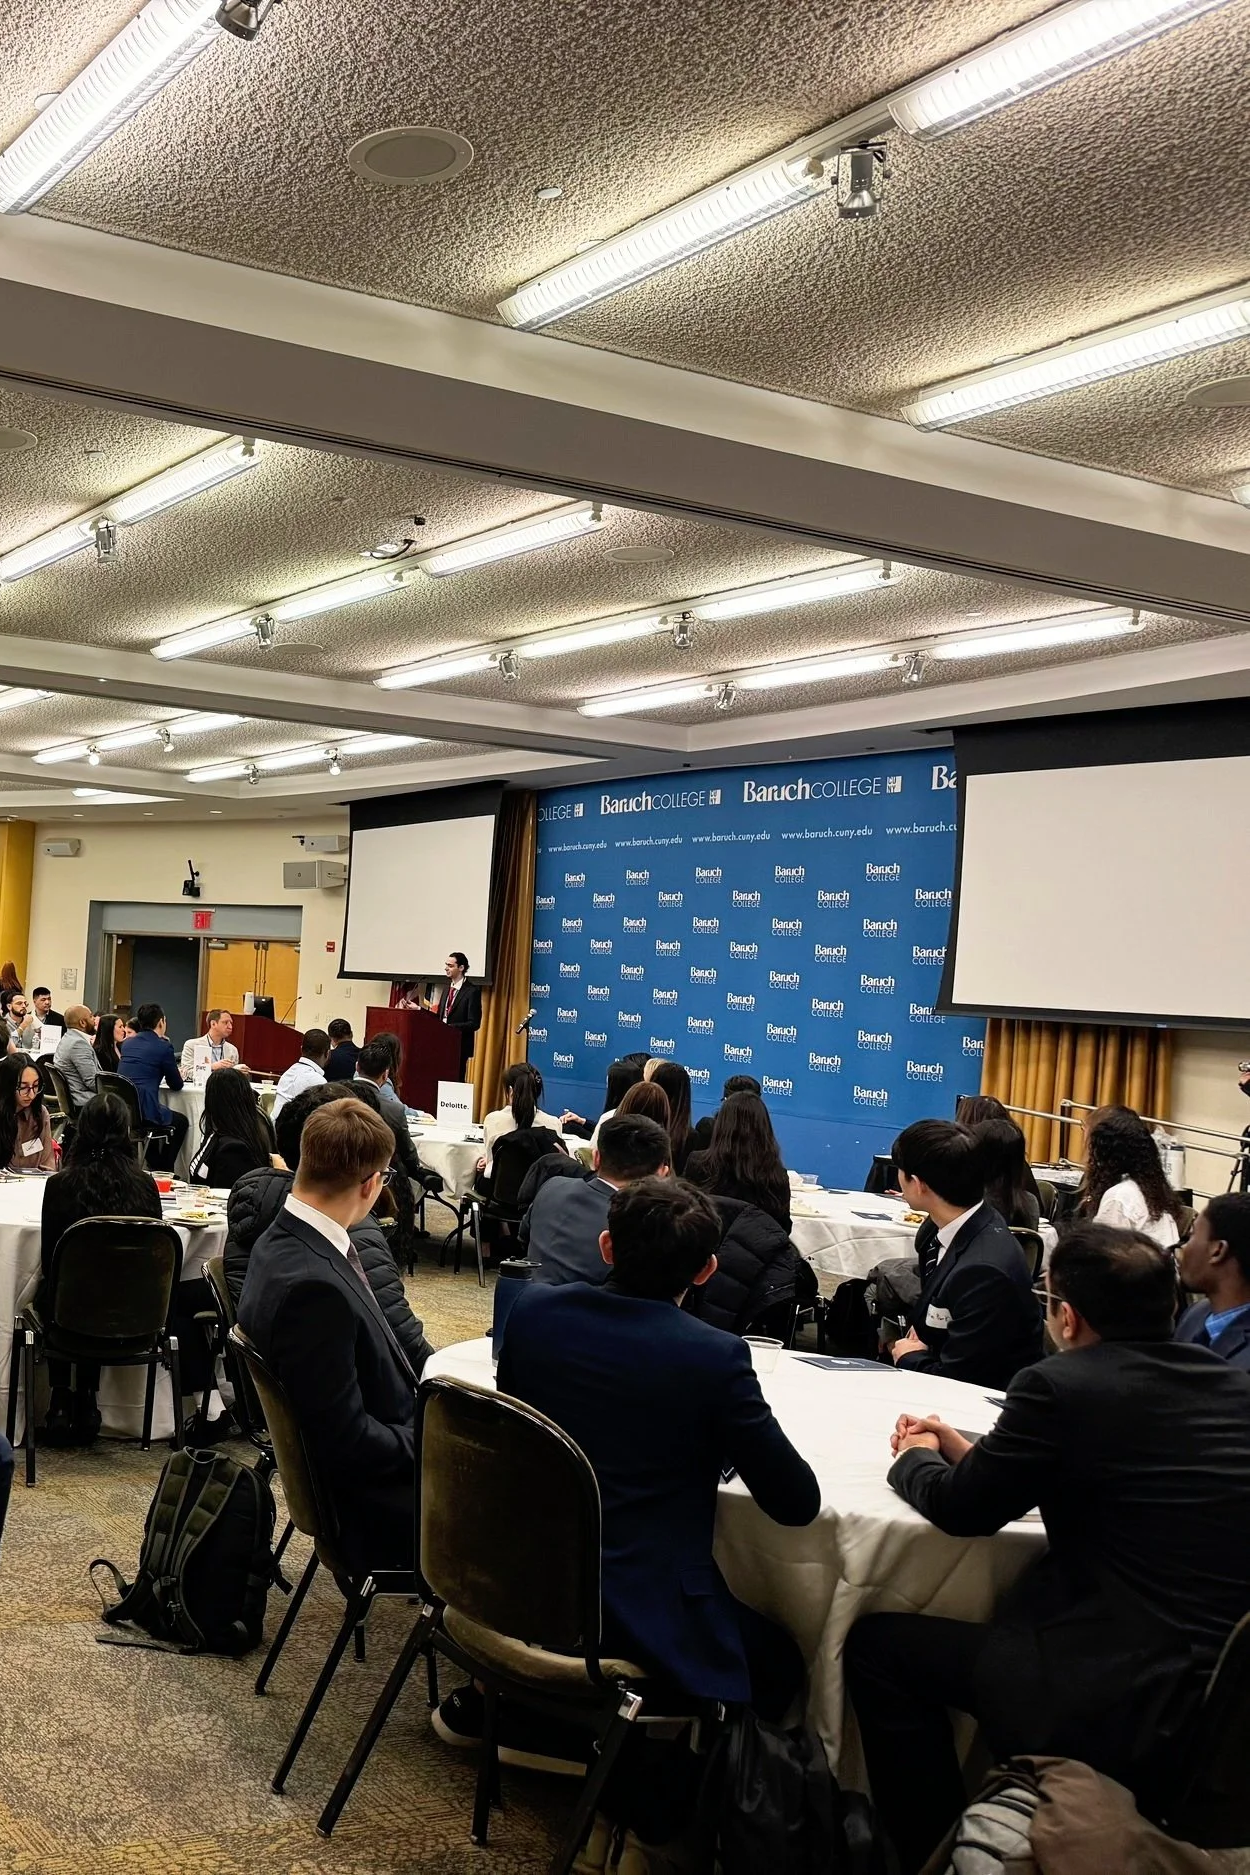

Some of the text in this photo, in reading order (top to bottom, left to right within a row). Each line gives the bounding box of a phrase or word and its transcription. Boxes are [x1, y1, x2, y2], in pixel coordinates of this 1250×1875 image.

[692, 830, 770, 844] www.baruch.cuny.edu
[781, 825, 872, 840] www.baruch.cuny.edu
[615, 835, 683, 848] www.baruch.cuny.edu
[696, 867, 722, 877] Baruch
[775, 866, 804, 877] Baruch
[866, 863, 900, 875] Baruch
[565, 873, 585, 882] Baruch
[626, 870, 649, 879] Baruch
[866, 873, 899, 881] COLLEGE
[695, 876, 721, 884] COLLEGE
[593, 893, 615, 902] Baruch
[659, 892, 683, 901] Baruch
[733, 890, 760, 900] Baruch
[818, 890, 849, 901] Baruch
[915, 888, 951, 900] Baruch
[536, 896, 555, 905] Baruch
[817, 900, 849, 908] COLLEGE
[562, 918, 582, 927] Baruch
[624, 917, 646, 927] Baruch
[693, 917, 719, 927] Baruch
[772, 918, 802, 929] Baruch
[863, 919, 897, 930] Baruch
[693, 926, 718, 934] COLLEGE
[863, 929, 897, 938] COLLEGE
[534, 939, 552, 948] Baruch
[591, 939, 612, 948] Baruch
[656, 940, 680, 950] Baruch
[730, 942, 758, 953] Baruch
[815, 944, 846, 956] Baruch
[815, 955, 846, 963] COLLEGE
[560, 963, 580, 972] Baruch
[621, 964, 644, 975] Baruch
[691, 967, 716, 978] Baruch
[770, 971, 799, 983] Baruch
[861, 975, 895, 987] Baruch
[531, 983, 550, 993] Baruch
[588, 985, 609, 995] Baruch
[769, 981, 799, 990] COLLEGE
[860, 986, 894, 994] COLLEGE
[653, 989, 677, 999] Baruch
[727, 993, 755, 1005] Baruch
[727, 1003, 754, 1011] COLLEGE
[812, 998, 843, 1011] Baruch
[910, 1003, 935, 1015] Baru
[557, 1008, 577, 1017] Baruch
[618, 1011, 641, 1023] Baruch
[811, 1009, 843, 1018] COLLEGE
[688, 1017, 714, 1029] Baruch
[909, 1014, 946, 1023] COLLEGE
[528, 1027, 547, 1036] Baruch
[687, 1026, 713, 1035] COLLEGE
[767, 1023, 796, 1036] Baruch
[585, 1031, 607, 1042] Baruch
[766, 1034, 796, 1043] COLLEGE
[858, 1030, 892, 1044] Baruch
[650, 1037, 675, 1048] Baruch
[857, 1041, 891, 1051] COLLEGE
[650, 1047, 674, 1055] COLLEGE
[724, 1044, 752, 1056] Baruch
[554, 1052, 574, 1062] Baruch
[724, 1054, 752, 1063] COLLEGE
[809, 1053, 841, 1066] Baruch
[809, 1063, 840, 1073] COLLEGE
[907, 1061, 943, 1075] Baruch
[906, 1071, 942, 1082] COLLEGE
[763, 1076, 792, 1089] Baruch
[762, 1086, 792, 1096] COLLEGE
[854, 1086, 888, 1100] Baruch
[440, 1101, 470, 1110] Deloitte.
[853, 1097, 887, 1107] COLLEGE
